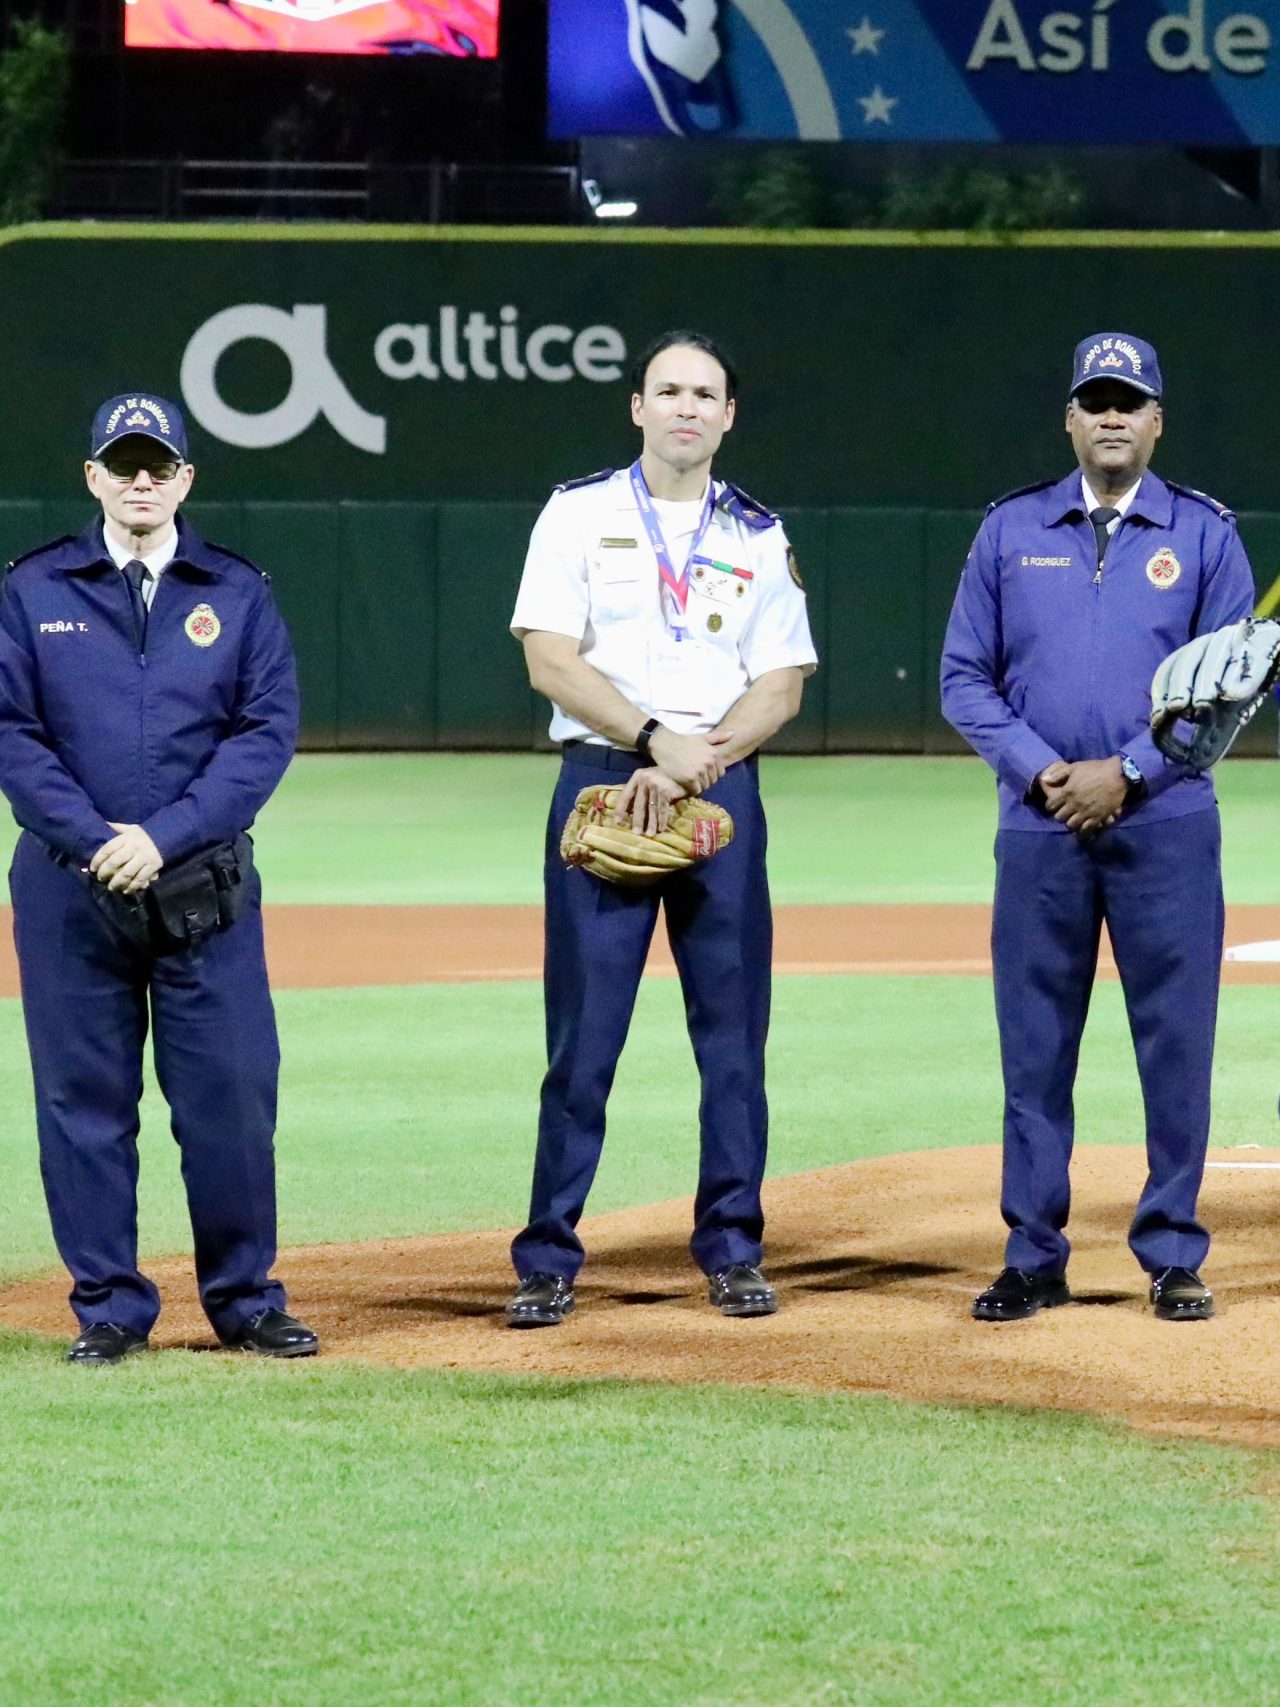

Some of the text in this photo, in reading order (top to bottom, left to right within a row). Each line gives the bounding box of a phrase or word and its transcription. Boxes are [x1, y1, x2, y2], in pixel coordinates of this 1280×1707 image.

[965, 0, 1115, 71] Así
[1146, 0, 1271, 73] de
[373, 305, 628, 382] altice
[1082, 338, 1142, 376] CUERPO DE BOMBEROS
[105, 398, 170, 435] CUERPO DE BOMBEROS
[39, 620, 89, 633] PEÑA T.
